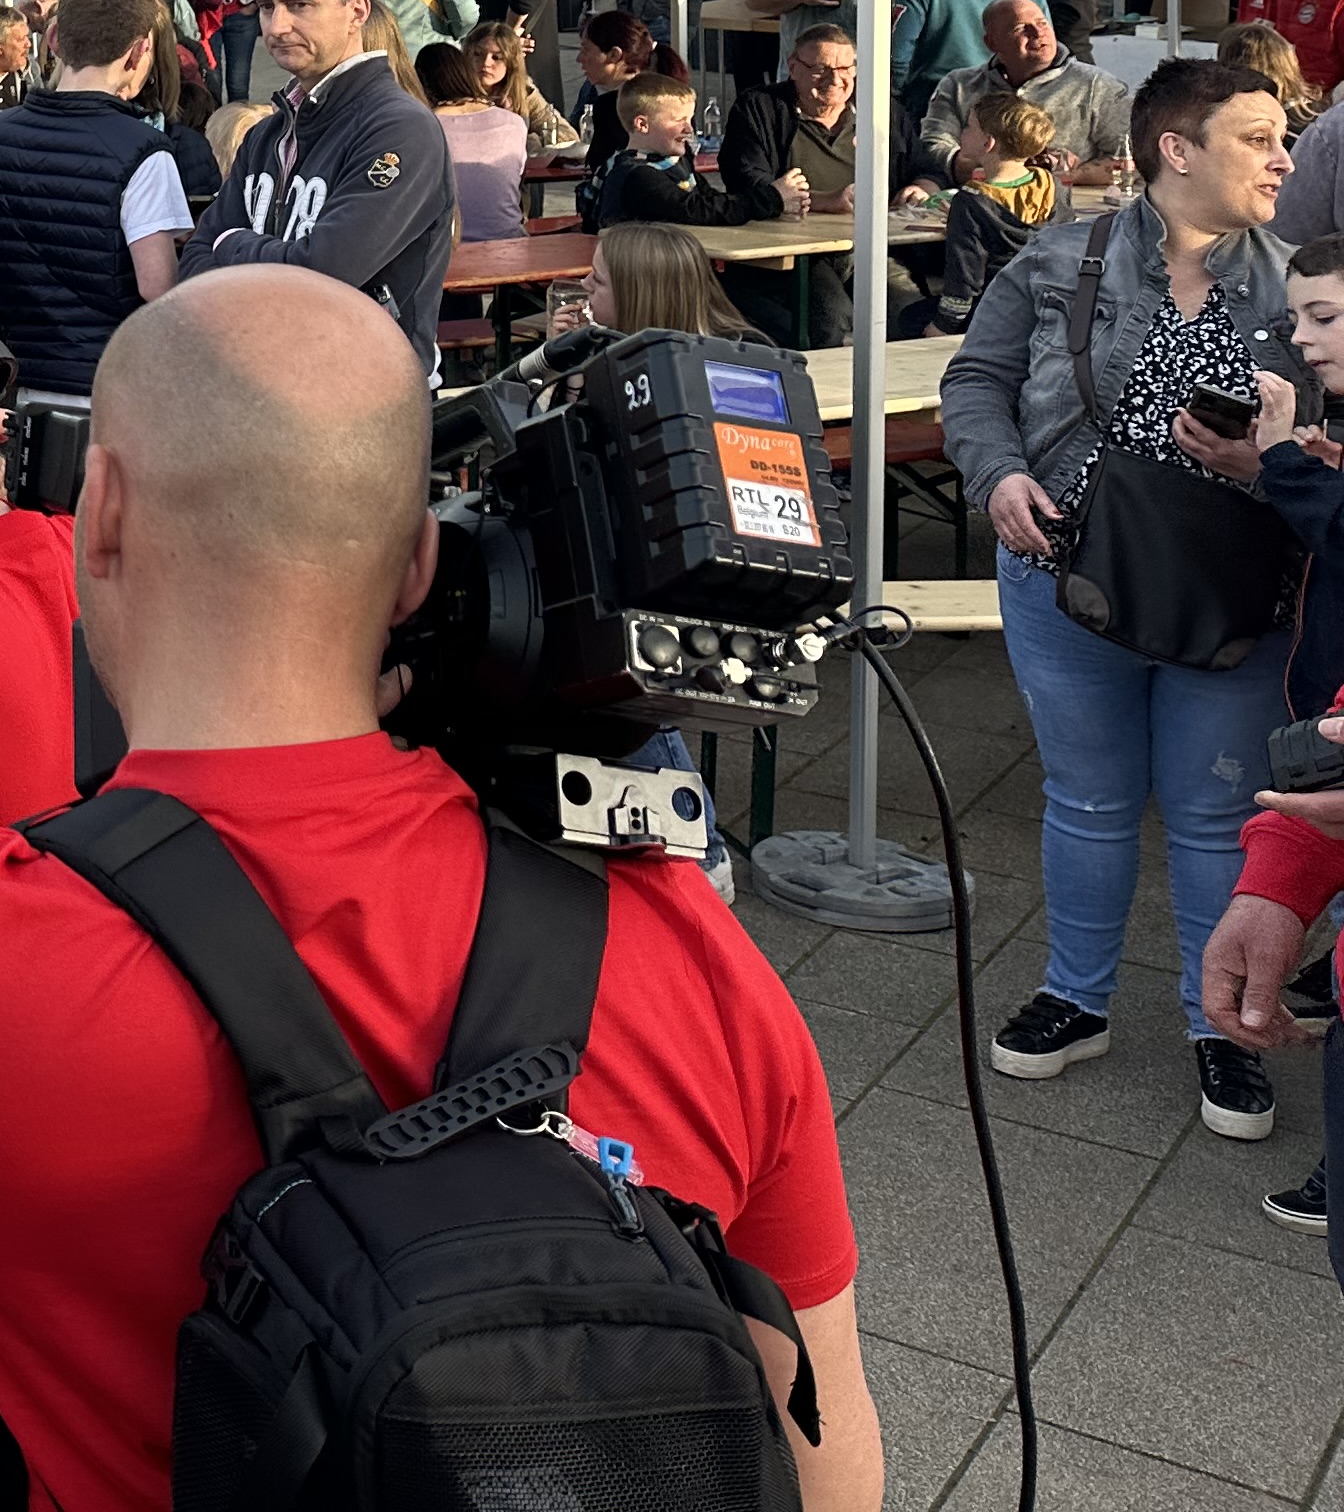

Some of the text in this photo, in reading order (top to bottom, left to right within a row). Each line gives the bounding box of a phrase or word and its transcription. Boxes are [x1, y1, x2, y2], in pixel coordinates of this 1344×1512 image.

[721, 427, 796, 453] Dynacore
[731, 486, 802, 522] RTL 29
